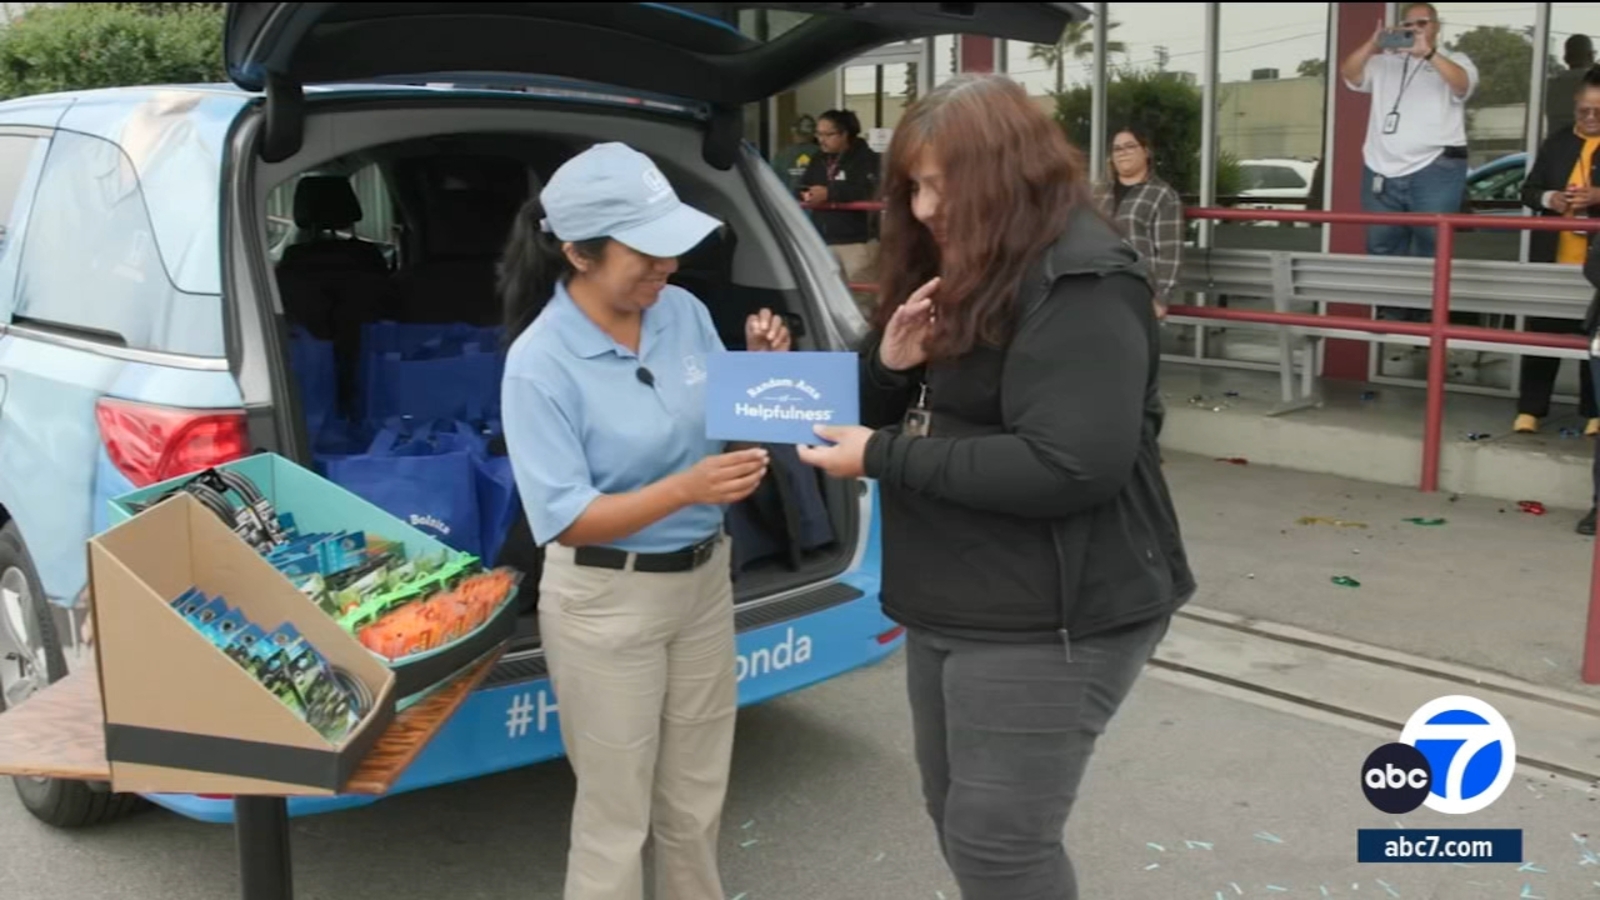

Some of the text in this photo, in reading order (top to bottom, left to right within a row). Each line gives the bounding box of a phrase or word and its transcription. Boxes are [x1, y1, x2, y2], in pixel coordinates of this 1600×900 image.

[746, 378, 821, 400] Random Acts
[735, 402, 834, 421] Helpfulness
